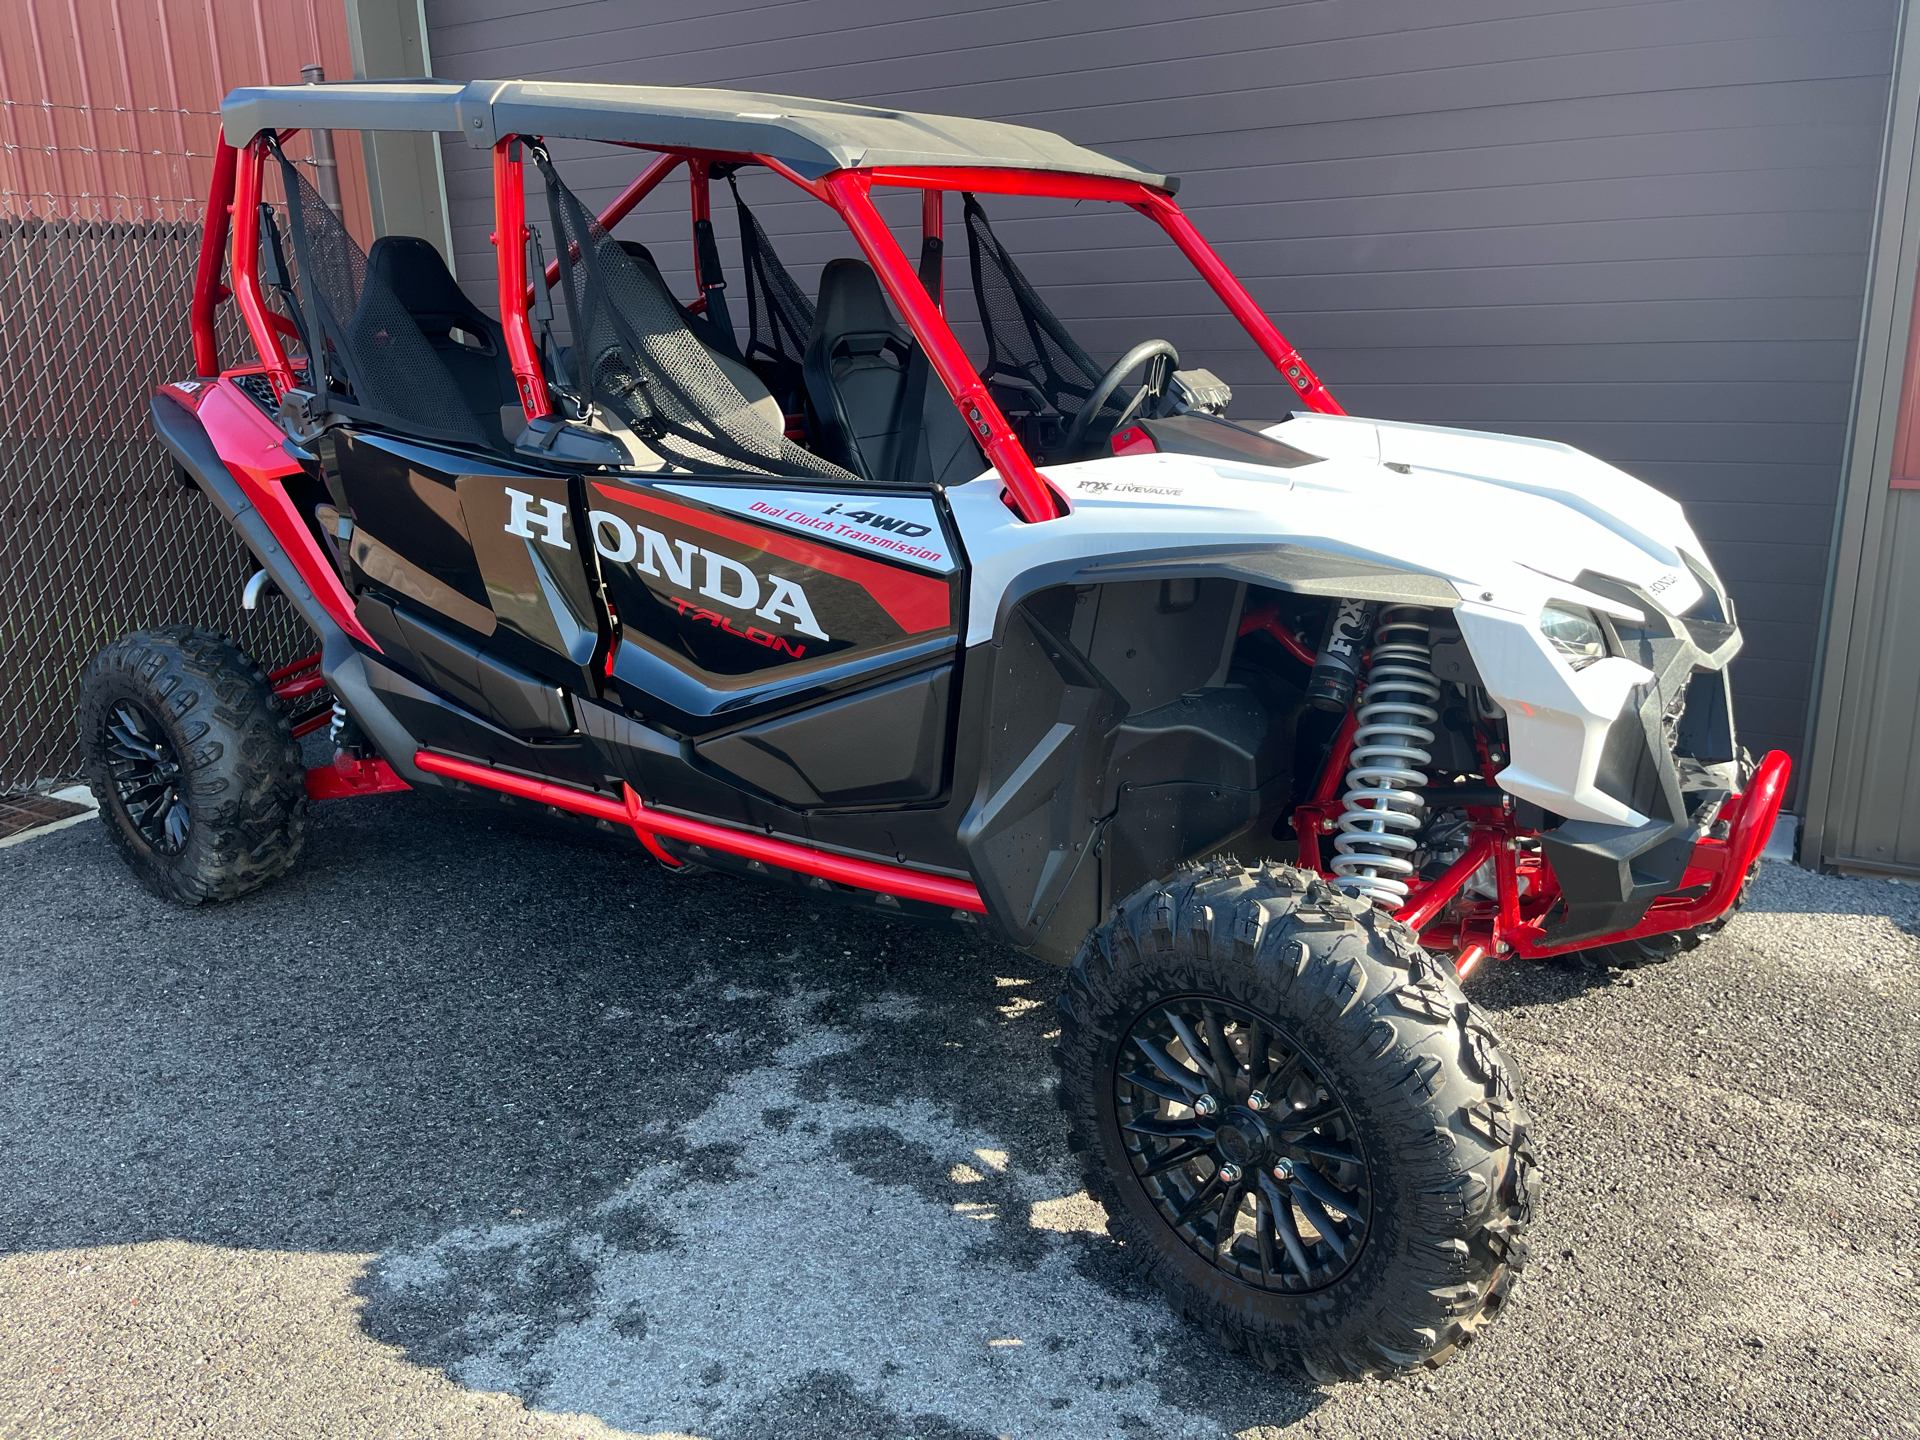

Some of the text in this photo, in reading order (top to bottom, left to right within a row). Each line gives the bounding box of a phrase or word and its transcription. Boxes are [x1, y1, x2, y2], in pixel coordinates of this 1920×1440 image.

[1077, 481, 1184, 496] FOX LIVEVALVE
[748, 501, 942, 563] Dual Clutch Transmission
[822, 503, 932, 538] i-4WD
[504, 486, 830, 642] HONDA
[670, 596, 806, 658] TALON
[1326, 597, 1366, 657] FOX
